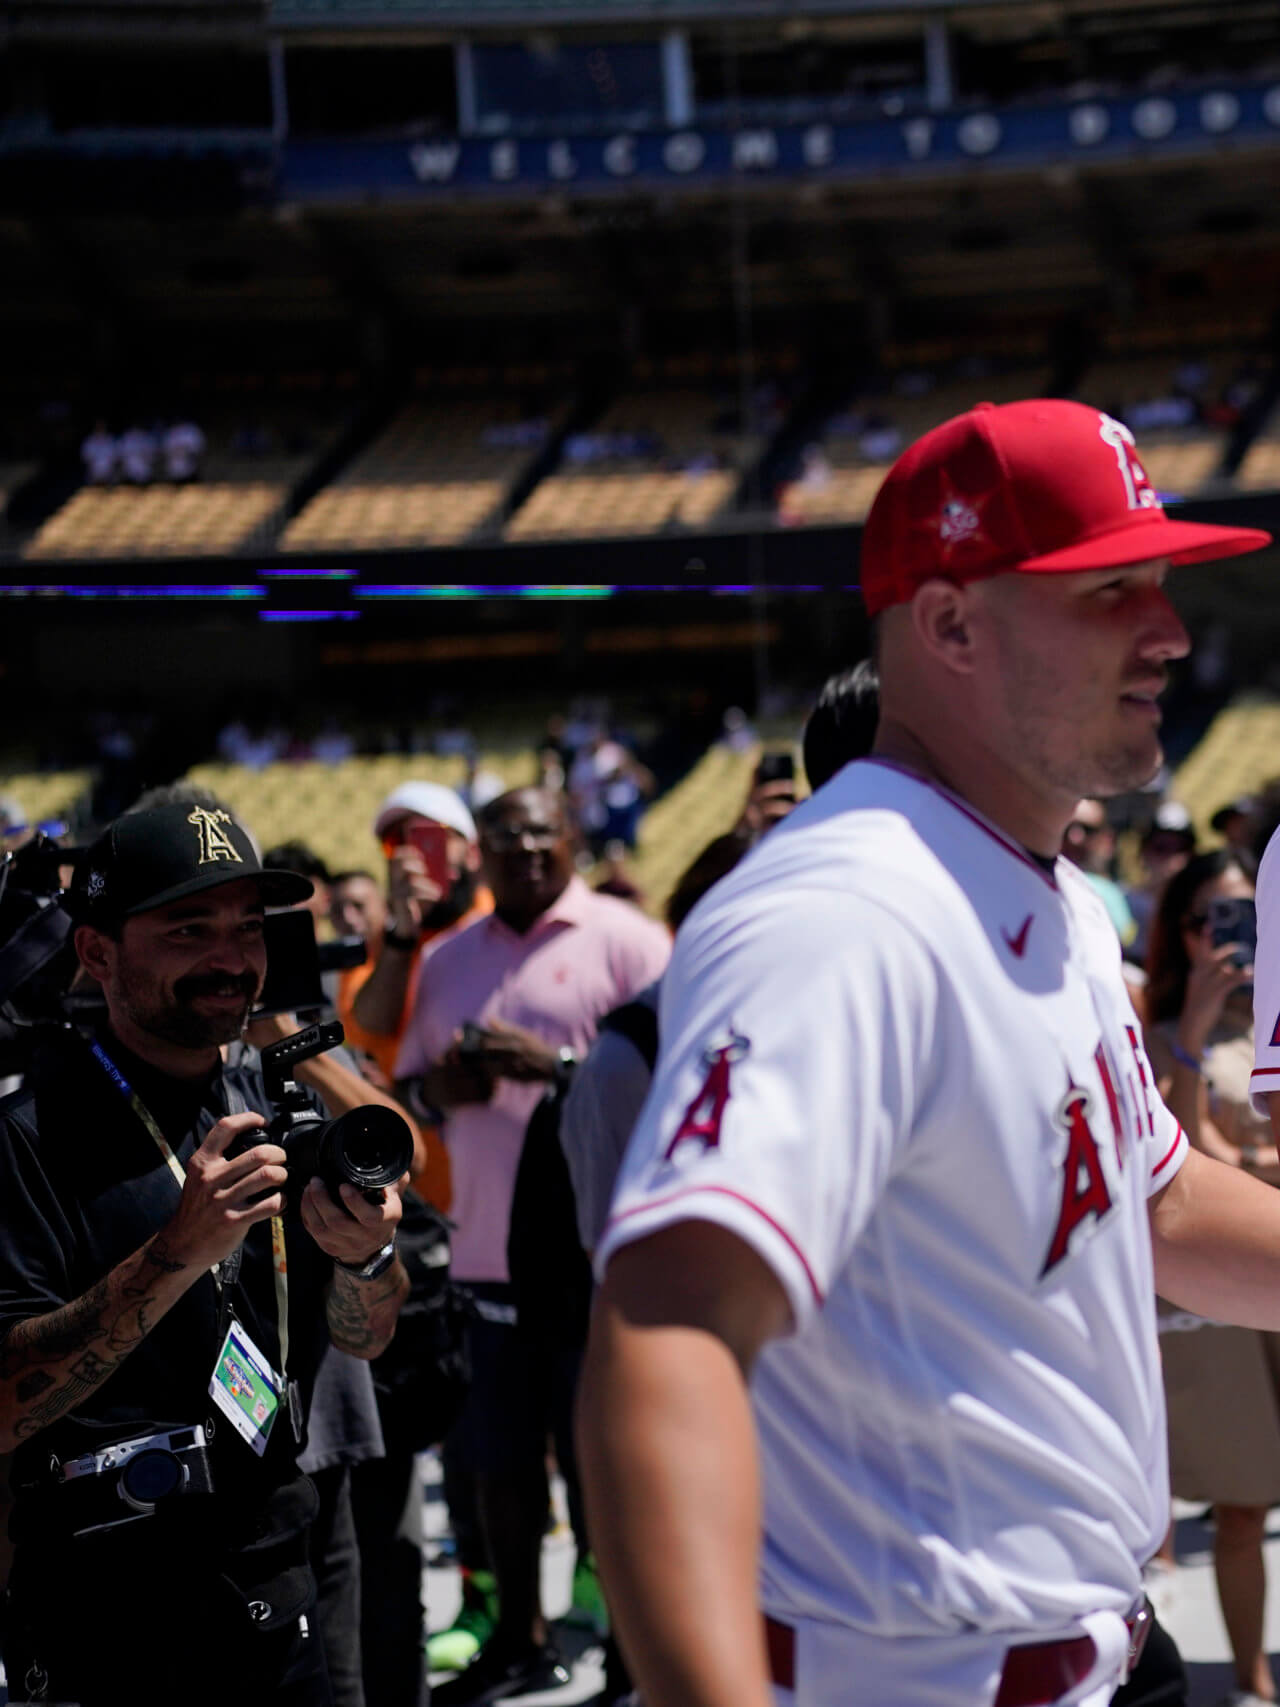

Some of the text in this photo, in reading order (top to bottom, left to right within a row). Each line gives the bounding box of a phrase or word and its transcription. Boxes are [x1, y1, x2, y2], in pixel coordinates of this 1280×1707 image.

[410, 125, 834, 182] WELCOME
[904, 112, 1000, 159] TO
[187, 805, 243, 865] A
[664, 1026, 751, 1164] A
